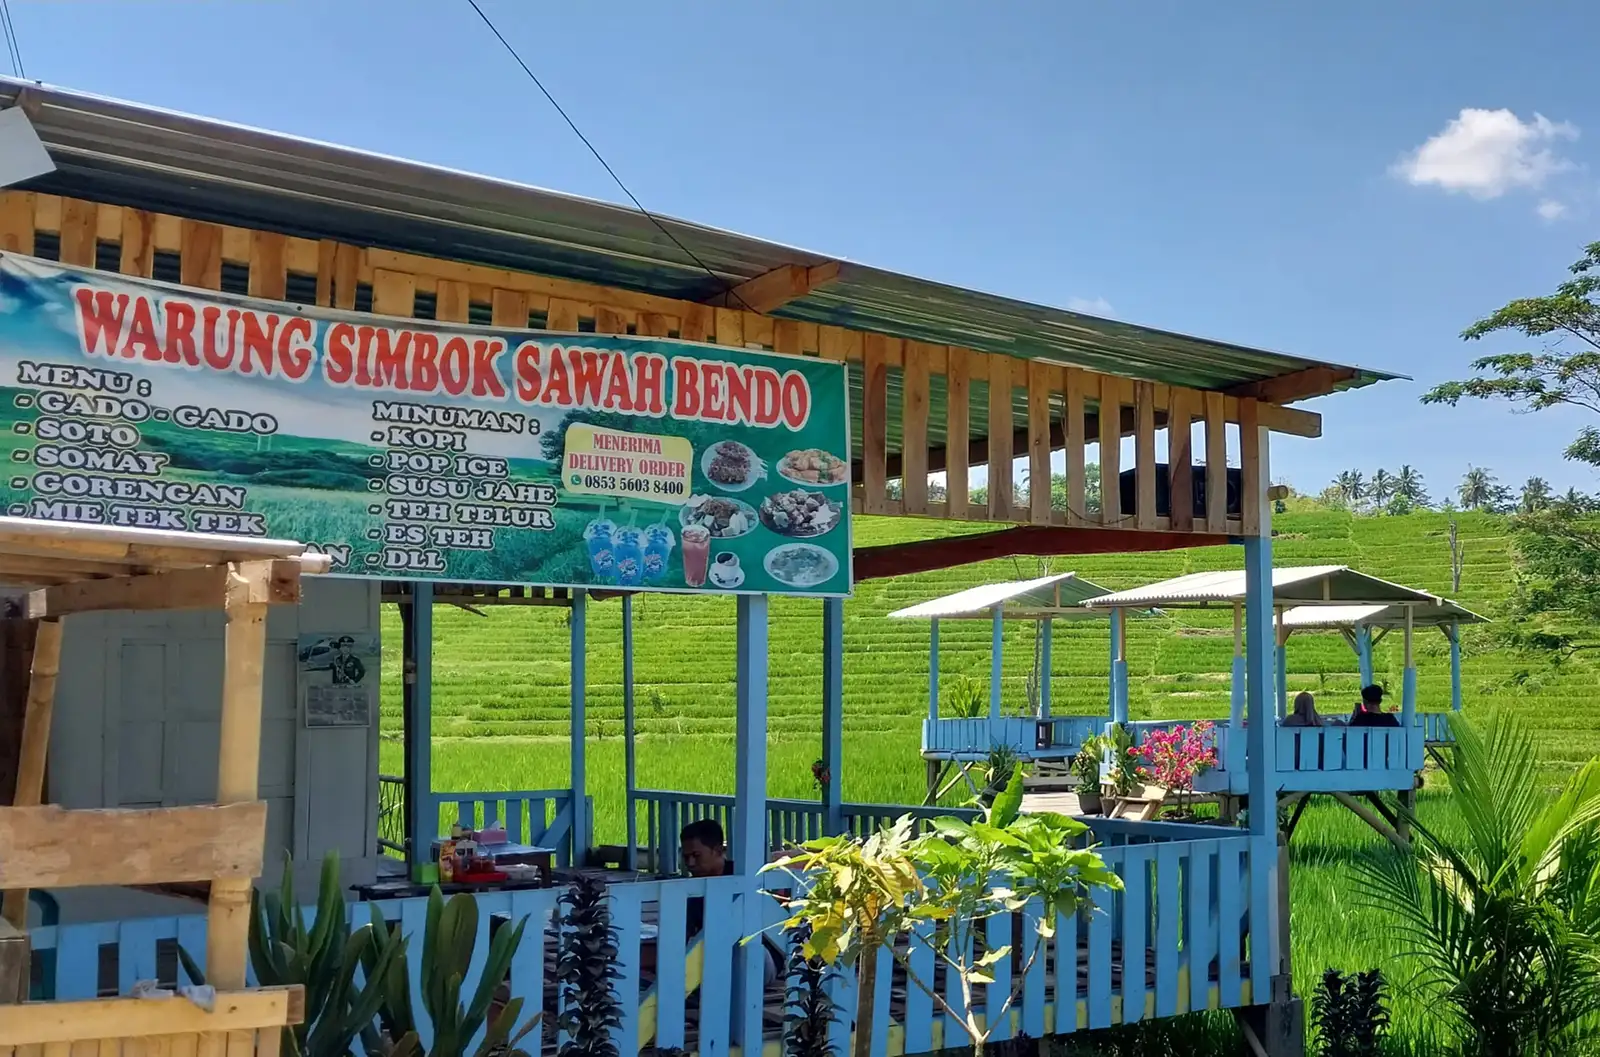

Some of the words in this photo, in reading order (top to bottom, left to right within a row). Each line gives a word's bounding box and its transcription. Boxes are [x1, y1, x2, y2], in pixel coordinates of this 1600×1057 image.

[74, 286, 313, 380] WARUNG
[325, 321, 507, 398] SIMBOK
[515, 343, 664, 414] SAWAH
[672, 358, 810, 428] BENDO
[19, 362, 131, 392] MENU
[373, 401, 523, 432] MINUMAN
[36, 418, 139, 446] SOTO
[389, 427, 466, 450] KOPI
[593, 433, 662, 455] MENERIMA
[35, 445, 167, 475] SOMAY
[388, 452, 449, 473] POP
[456, 456, 507, 477] ICE
[569, 453, 634, 474] DELIVERY
[638, 458, 685, 478] ORDER
[34, 472, 245, 508] GORENGAN
[388, 476, 470, 498] SUSU
[476, 483, 555, 504] JAHE
[584, 475, 616, 490] 0853
[619, 478, 650, 493] 5603
[653, 481, 684, 495] 8400
[32, 500, 104, 524] MIE
[112, 505, 187, 531] TEK
[193, 510, 266, 535] TEK
[387, 501, 449, 520] TEH
[456, 506, 554, 528] TELUR
[385, 524, 426, 544] ES
[431, 528, 493, 549] TEH
[384, 549, 444, 570] DLL
